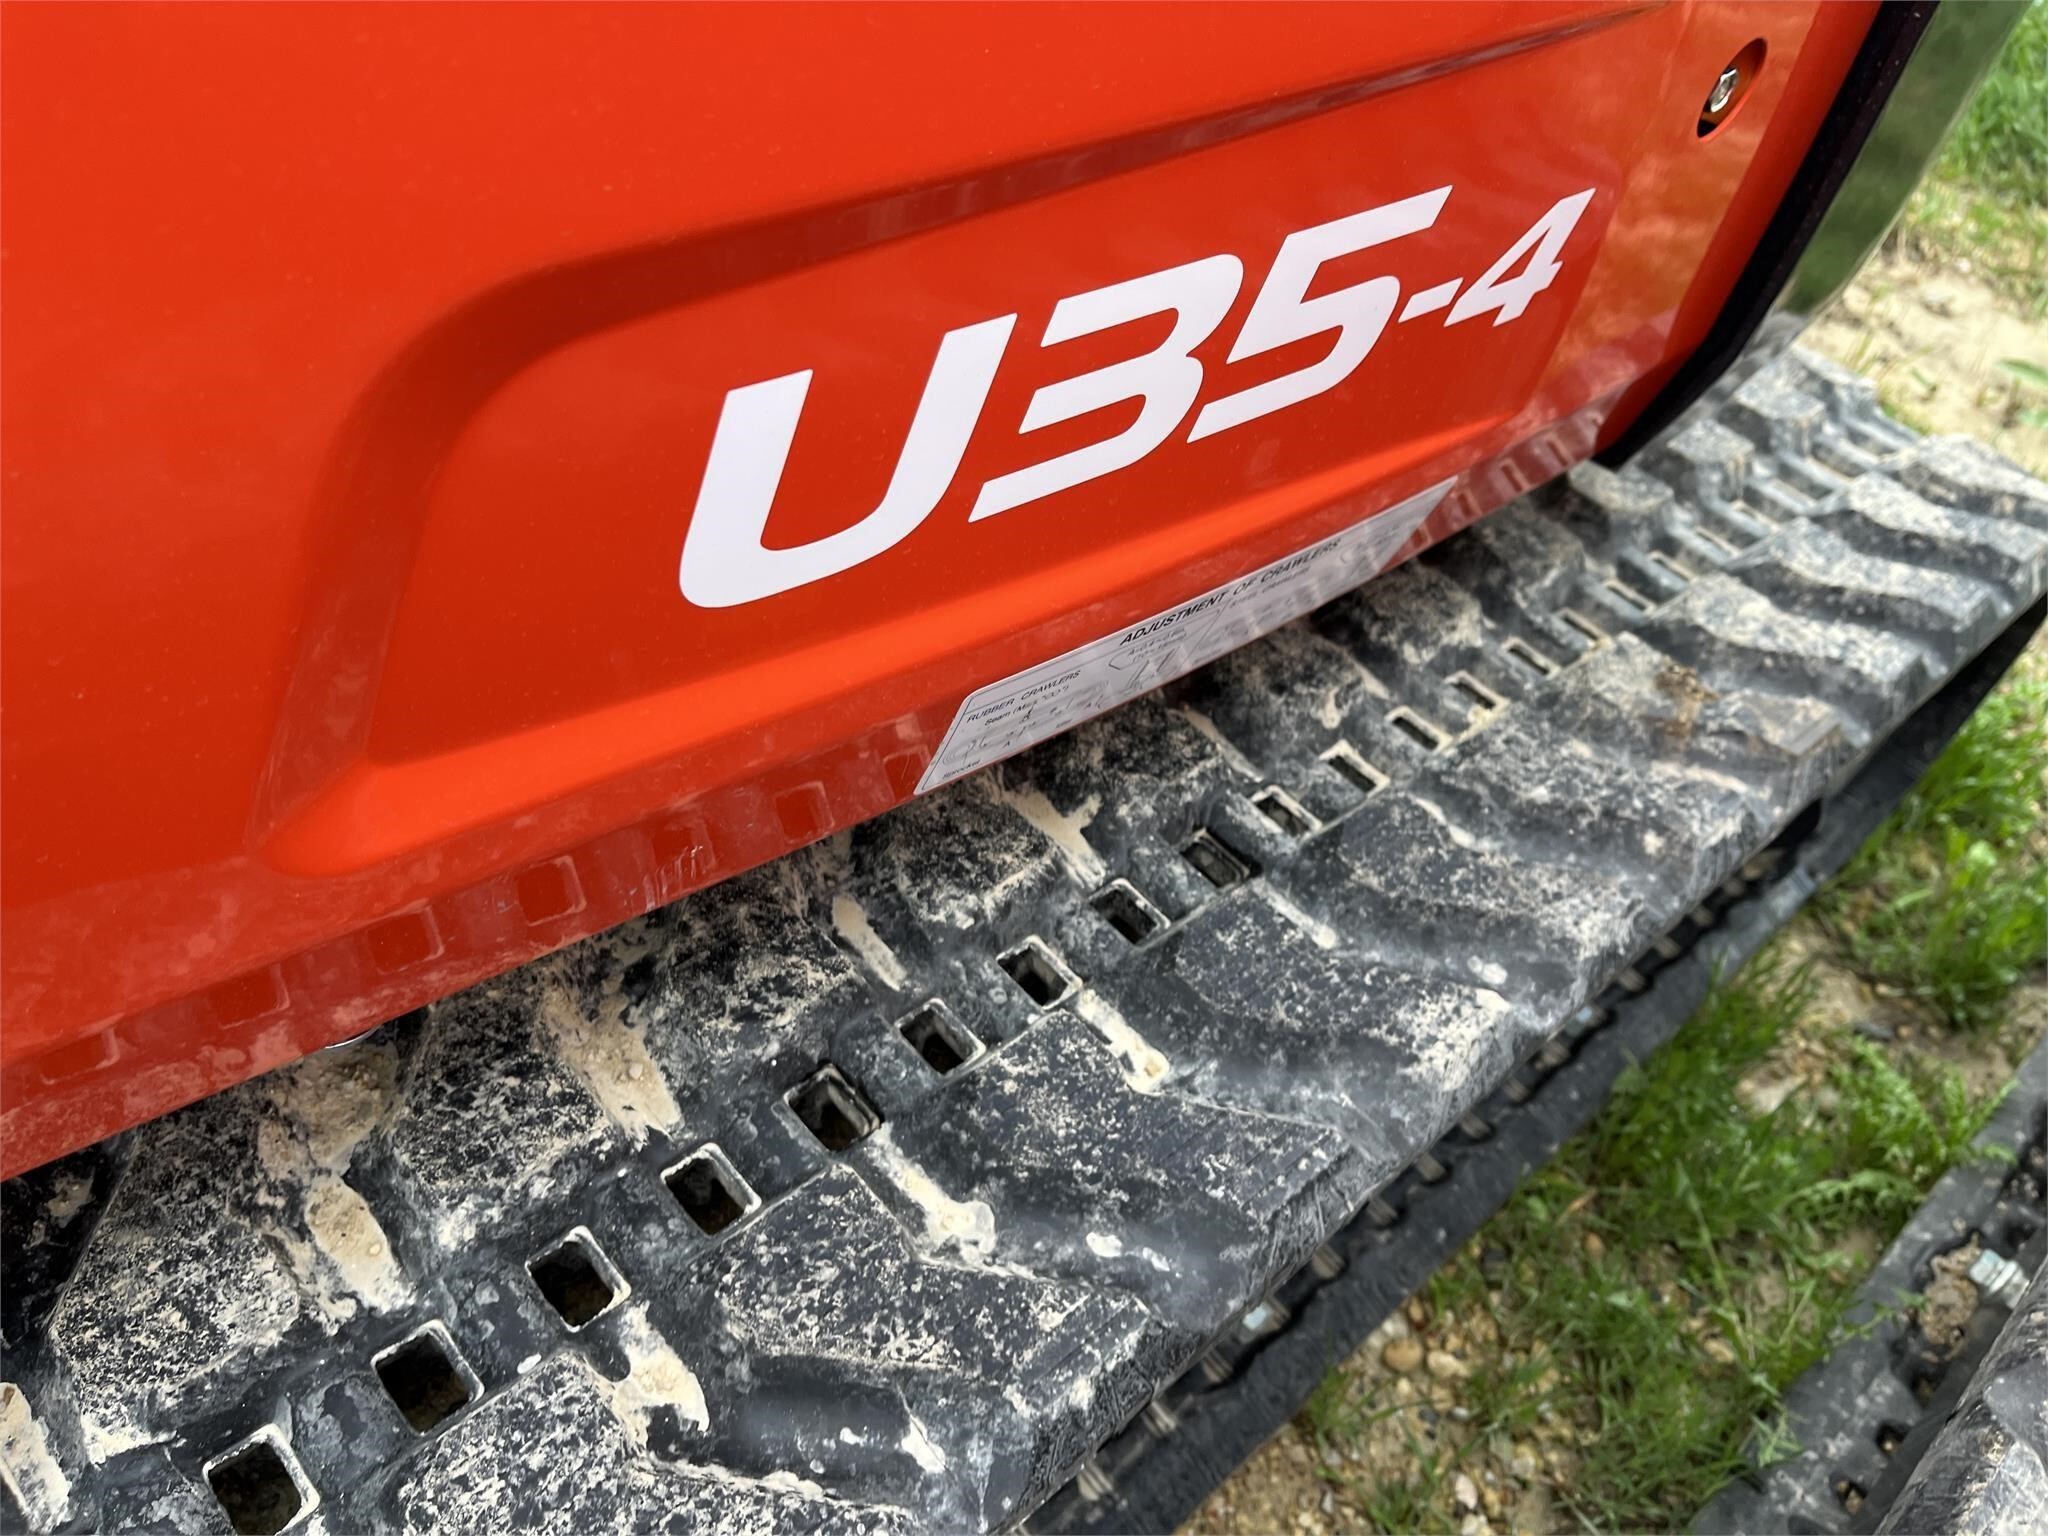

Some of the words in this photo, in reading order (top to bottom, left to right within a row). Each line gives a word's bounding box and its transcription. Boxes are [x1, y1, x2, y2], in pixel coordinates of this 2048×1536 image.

[678, 185, 1596, 607] U35-4
[1120, 591, 1227, 646] ADJUSTMENT
[1233, 577, 1258, 596] OF
[1260, 539, 1342, 583] CRAWLERS
[966, 698, 1016, 724] RUBBER
[1020, 669, 1082, 701] CRAWLERS
